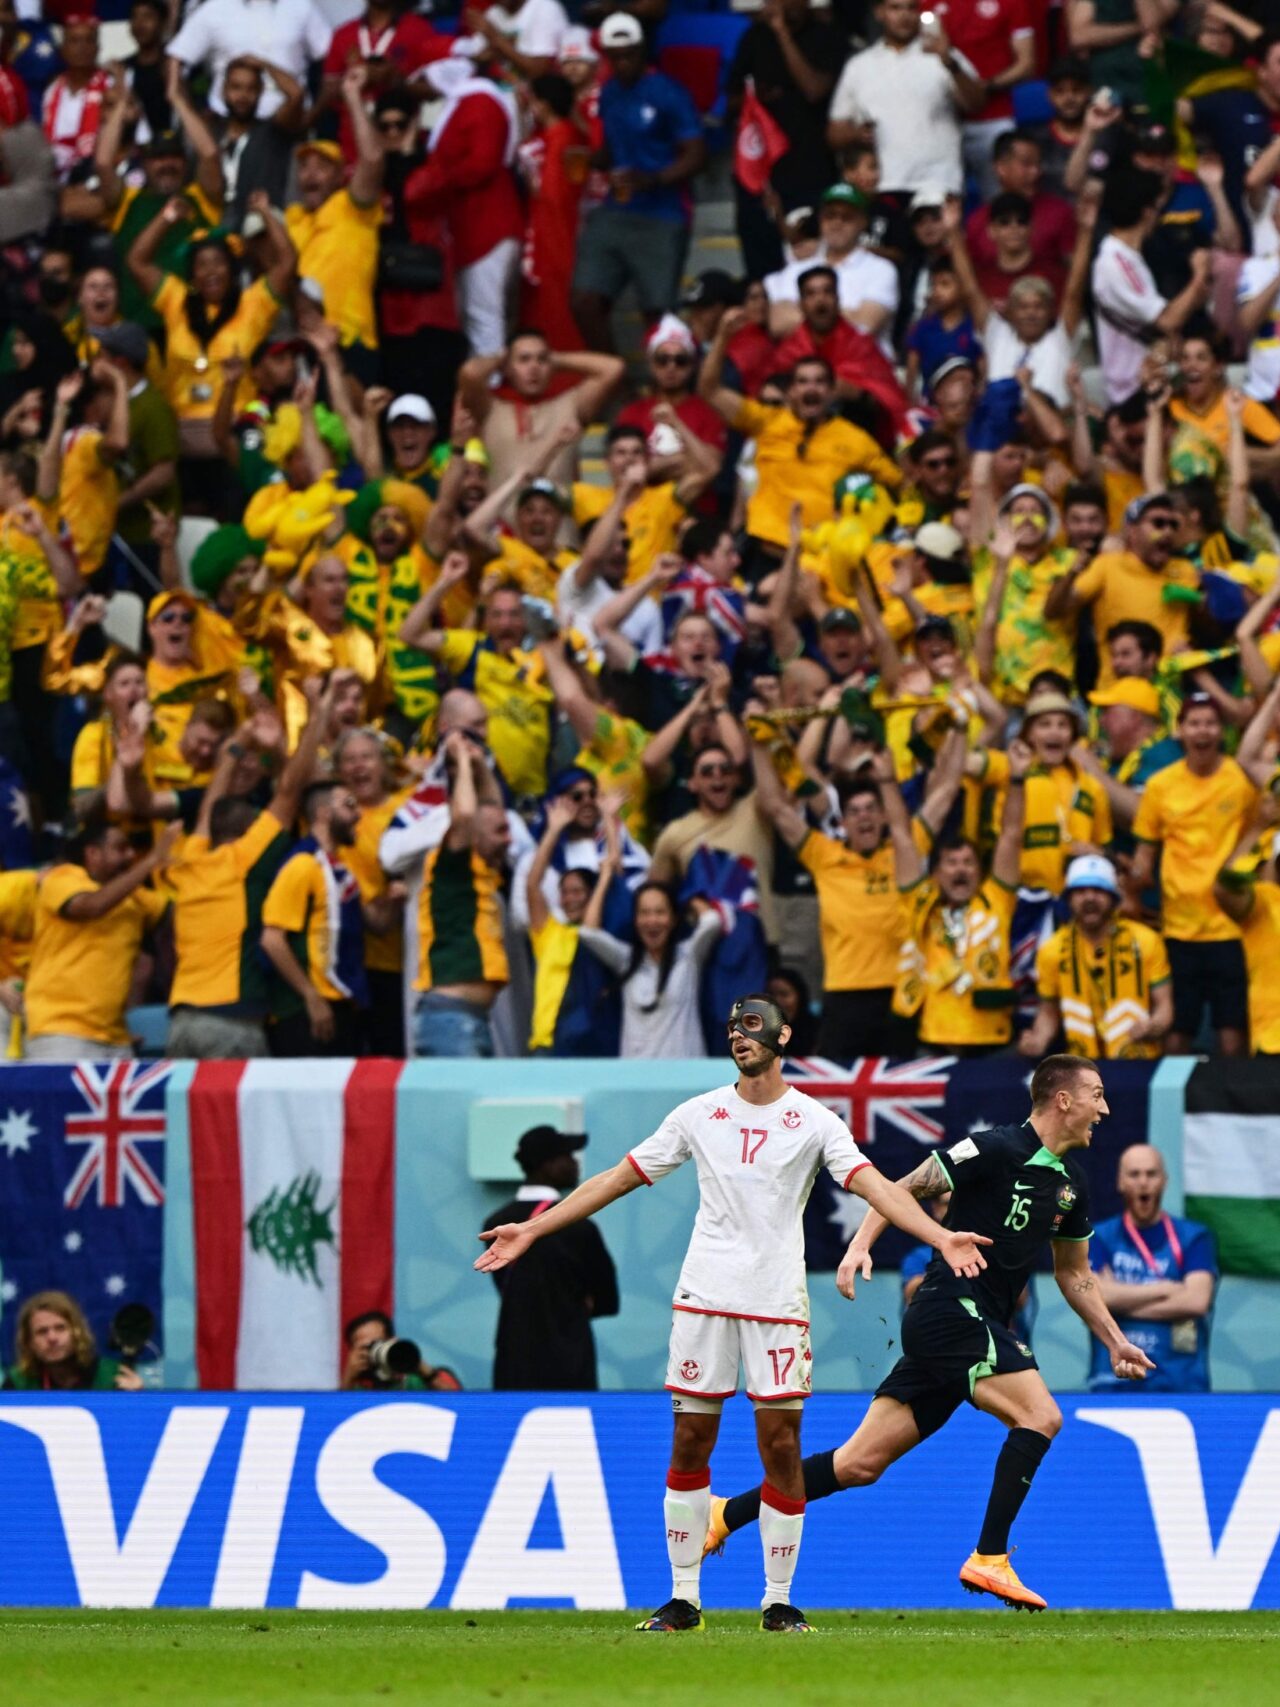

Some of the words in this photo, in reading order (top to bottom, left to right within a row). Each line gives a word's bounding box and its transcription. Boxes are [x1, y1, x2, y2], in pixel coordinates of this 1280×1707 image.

[740, 1128, 768, 1164] 17
[1004, 1194, 1032, 1231] 15
[768, 1347, 795, 1386] 17
[0, 1403, 627, 1609] VISA
[668, 1529, 689, 1542] FTF
[771, 1544, 796, 1557] FTF
